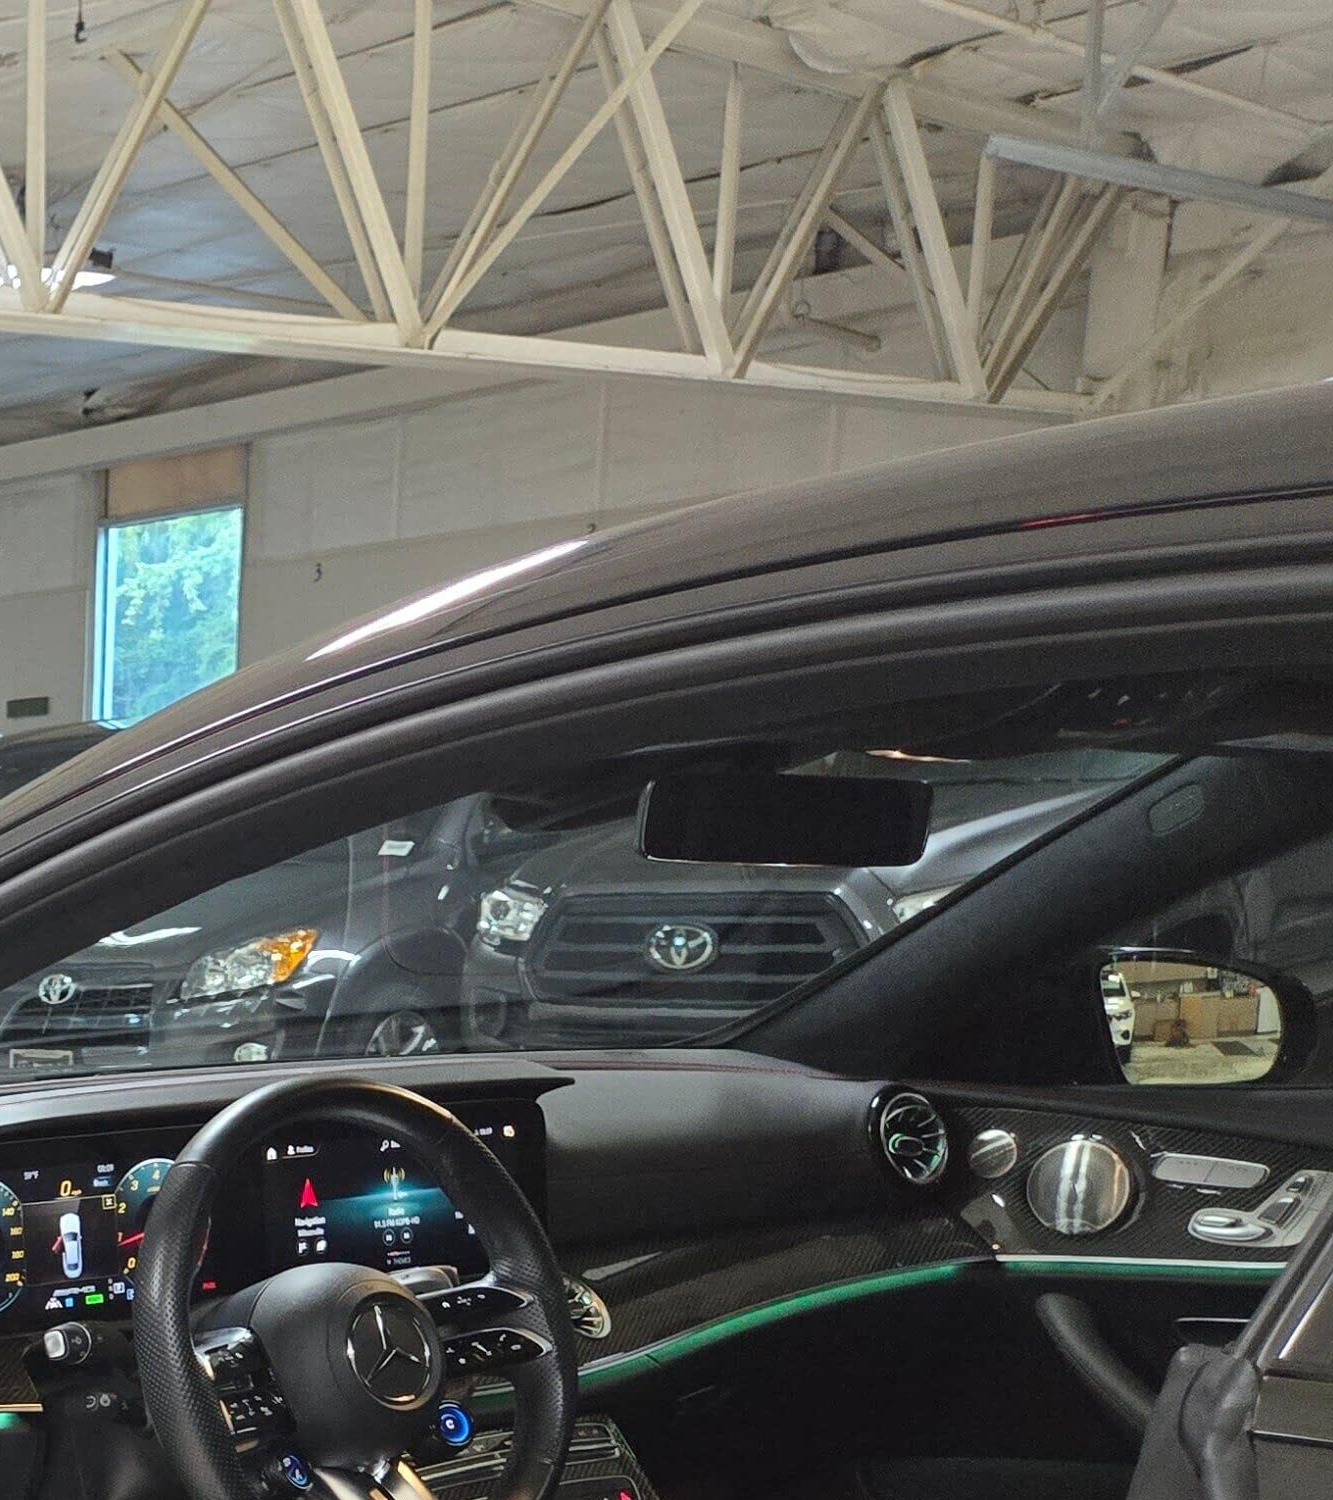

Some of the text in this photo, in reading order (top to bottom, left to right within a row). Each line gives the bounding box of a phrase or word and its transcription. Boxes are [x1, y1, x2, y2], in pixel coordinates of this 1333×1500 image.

[313, 562, 323, 583] 3
[152, 1169, 161, 1180] 4
[60, 1180, 71, 1197] 0
[130, 1180, 139, 1191] 3
[1, 1206, 15, 1217] 140
[117, 1202, 126, 1214] 2
[127, 1256, 136, 1268] 0
